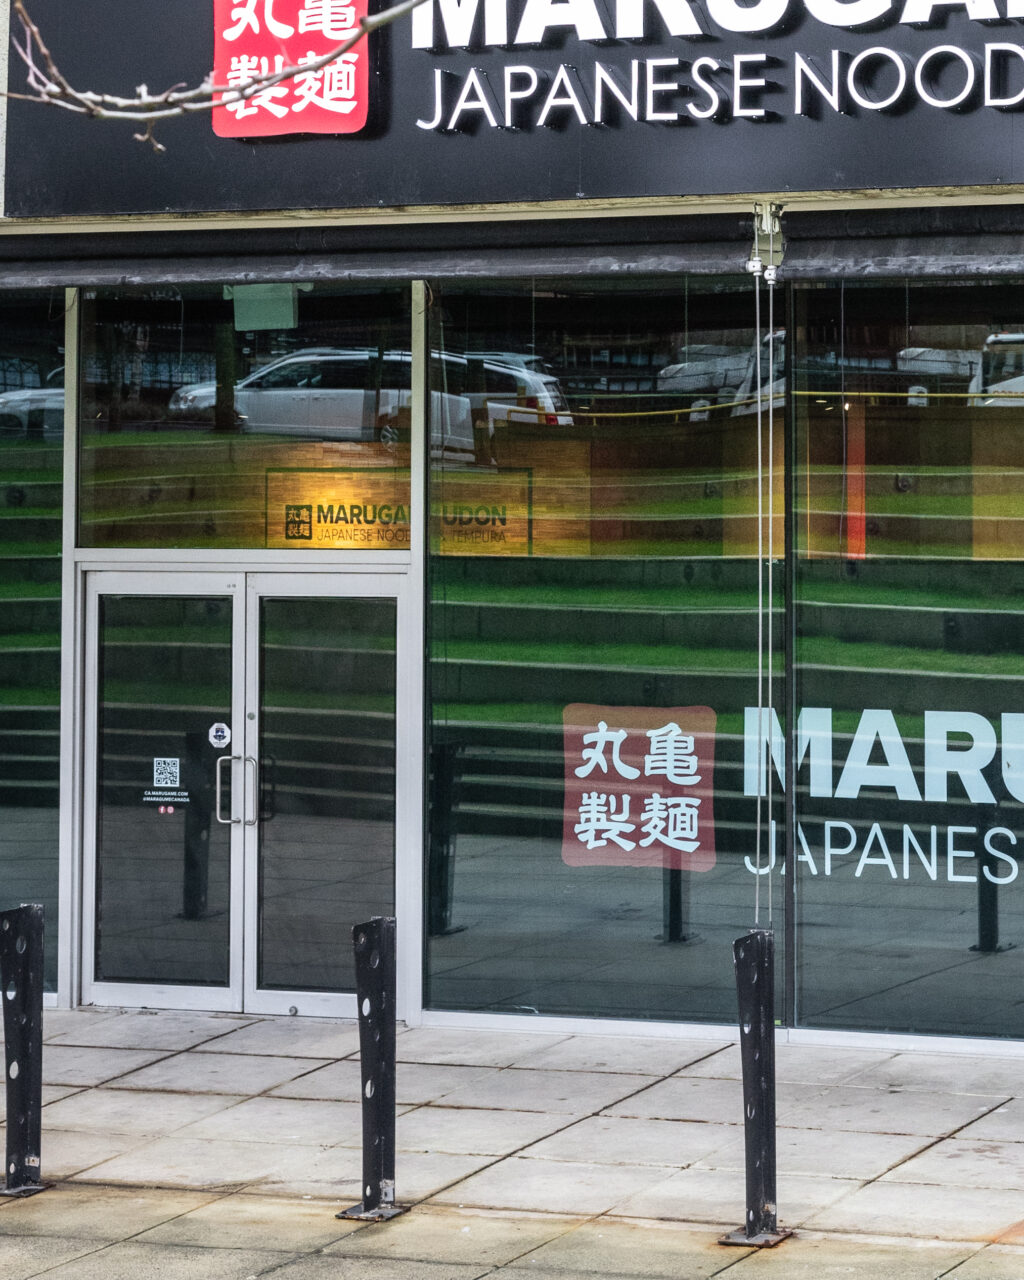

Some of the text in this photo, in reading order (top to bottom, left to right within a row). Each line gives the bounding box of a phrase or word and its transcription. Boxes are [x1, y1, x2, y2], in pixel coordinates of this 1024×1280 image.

[416, 52, 768, 130] JAPANESE
[317, 504, 507, 526] MARUGA UDON
[317, 528, 373, 542] JAPANESE
[573, 720, 702, 786] 丸亀
